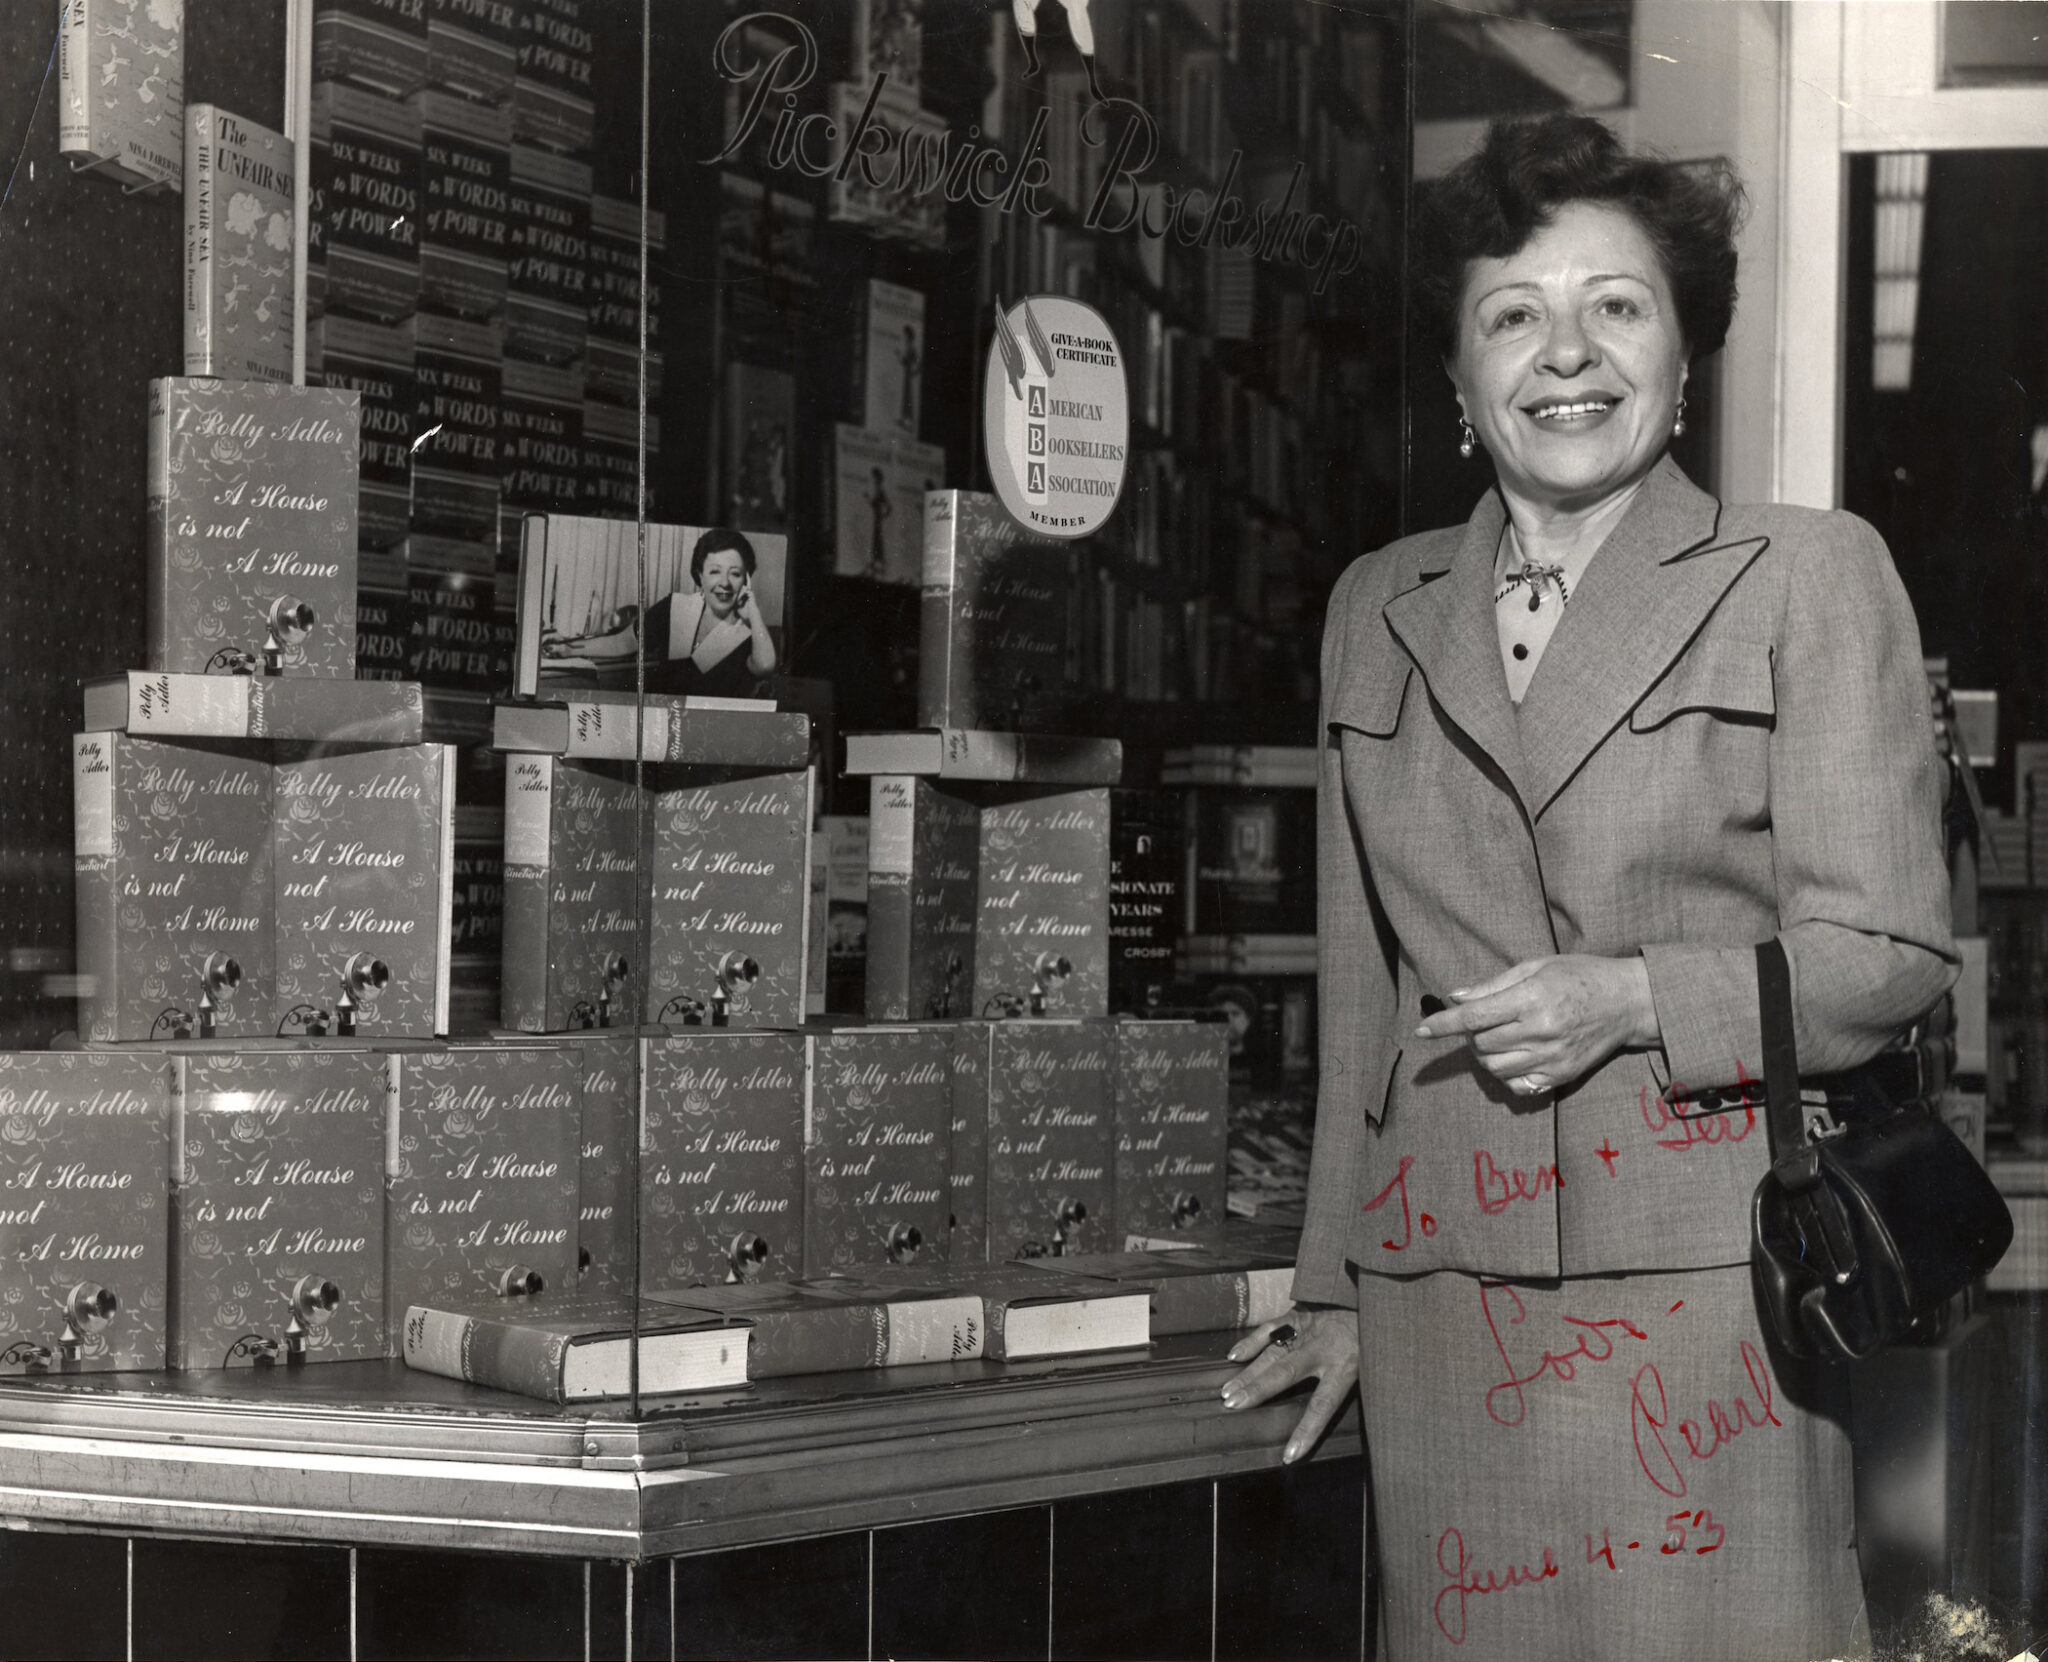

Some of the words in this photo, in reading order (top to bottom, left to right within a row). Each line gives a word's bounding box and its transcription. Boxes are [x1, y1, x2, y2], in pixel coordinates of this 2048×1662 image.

[218, 116, 247, 147] The
[199, 145, 209, 172] THE
[332, 142, 353, 159] SIX
[358, 145, 400, 174] WEEKS
[428, 147, 447, 166] SIX
[452, 150, 491, 177] WEEKS
[697, 12, 1053, 216] Pickwick
[1080, 98, 1363, 295] Bookshop
[218, 148, 272, 189] UNFAIR
[199, 179, 209, 232] UNFAIR
[333, 173, 346, 193] to
[350, 174, 417, 212] WORDS
[429, 178, 440, 195] to
[443, 177, 507, 212] WORDS
[332, 207, 348, 231] of
[350, 208, 414, 245] POWER
[427, 207, 443, 231] of
[444, 209, 505, 245] POWER
[199, 238, 209, 263] SEX
[1051, 333, 1113, 353] GIVE-A-BOOK
[1056, 348, 1117, 368] CERTIFICATE
[325, 372, 346, 389] SIX
[350, 374, 394, 398] WEEKS
[416, 366, 438, 385] SIX
[442, 368, 482, 393] WEEKS
[418, 399, 430, 416] to
[433, 394, 498, 429] WORDS
[194, 414, 265, 450] Polly
[271, 418, 342, 444] Adler
[438, 433, 495, 461] POWER
[214, 481, 248, 508] A
[251, 484, 328, 511] House
[178, 515, 197, 538] is
[206, 517, 253, 539] not
[1029, 511, 1086, 527] MEMBER
[226, 548, 260, 573] A
[263, 551, 339, 577] Home
[139, 684, 157, 720] Polly
[78, 743, 102, 758] Polly
[82, 761, 110, 775] Adler
[137, 768, 195, 804] Polly
[200, 770, 260, 796] Adler
[276, 773, 341, 807] Polly
[348, 774, 421, 800] Adler
[519, 780, 549, 793] Adler
[657, 790, 718, 820] Polly
[724, 793, 791, 816] Adler
[981, 808, 1029, 837] Polly
[1036, 810, 1095, 831] Adler
[154, 838, 180, 863] A
[184, 839, 249, 865] House
[292, 840, 326, 865] A
[328, 843, 405, 868] House
[672, 850, 703, 872] A
[705, 852, 776, 876] House
[124, 873, 140, 896] is
[148, 873, 185, 897] not
[284, 875, 328, 898] not
[990, 862, 1015, 883] A
[1020, 863, 1083, 885] House
[664, 881, 705, 901] not
[985, 890, 1021, 909] not
[1109, 881, 1176, 896] SIONATE
[167, 905, 195, 931] A
[196, 905, 260, 932] Home
[302, 906, 338, 932] A
[339, 908, 415, 935] Home
[681, 909, 713, 931] A
[714, 912, 783, 936] Home
[1110, 903, 1164, 917] YEARS
[1000, 915, 1028, 936] A
[1030, 917, 1092, 937] Home
[1124, 947, 1173, 959] CROSBY
[1011, 1050, 1057, 1079] Polly
[1061, 1050, 1107, 1071] Adler
[1131, 1050, 1174, 1078] Polly
[1176, 1049, 1220, 1070] Adler
[669, 1068, 729, 1100] Polly
[733, 1067, 793, 1091] Adler
[834, 1063, 888, 1094] Polly
[891, 1063, 946, 1086] Adler
[67, 1089, 149, 1120] Adler
[293, 1087, 371, 1114] Adler
[427, 1085, 496, 1120] Polly
[501, 1083, 574, 1110] Adler
[1140, 1103, 1163, 1125] A
[1163, 1103, 1210, 1124] House
[1022, 1105, 1045, 1126] A
[1046, 1105, 1097, 1127] House
[685, 1129, 712, 1153] A
[716, 1130, 781, 1154] House
[847, 1123, 874, 1146] A
[875, 1123, 935, 1146] House
[998, 1136, 1011, 1154] is
[1016, 1134, 1046, 1154] not
[1119, 1133, 1132, 1151] is
[1136, 1131, 1164, 1151] not
[5, 1161, 43, 1189] A
[46, 1161, 133, 1190] House
[234, 1158, 271, 1186] A
[272, 1158, 355, 1186] House
[446, 1153, 483, 1180] A
[485, 1153, 559, 1180] House
[655, 1164, 672, 1185] is
[679, 1162, 718, 1185] not
[820, 1157, 836, 1178] is
[841, 1154, 876, 1177] not
[1030, 1159, 1053, 1181] A
[1053, 1159, 1103, 1181] Home
[1147, 1154, 1170, 1177] A
[1168, 1155, 1215, 1175] Home
[411, 1191, 430, 1215] is
[435, 1189, 484, 1215] not
[694, 1190, 724, 1216] A
[725, 1190, 789, 1214] Home
[856, 1182, 883, 1208] A
[884, 1180, 941, 1205] Home
[1362, 1155, 1439, 1251] To
[1474, 1149, 1567, 1215] Ben
[0, 1200, 46, 1225] not
[196, 1199, 217, 1222] is
[226, 1196, 275, 1222] not
[19, 1231, 58, 1262] A
[61, 1233, 145, 1261] Home
[247, 1228, 284, 1256] A
[285, 1229, 366, 1256] Home
[459, 1221, 494, 1248] A
[496, 1222, 568, 1248] Home
[1630, 1340, 1782, 1497] Pearl
[1435, 1527, 1558, 1645] June
